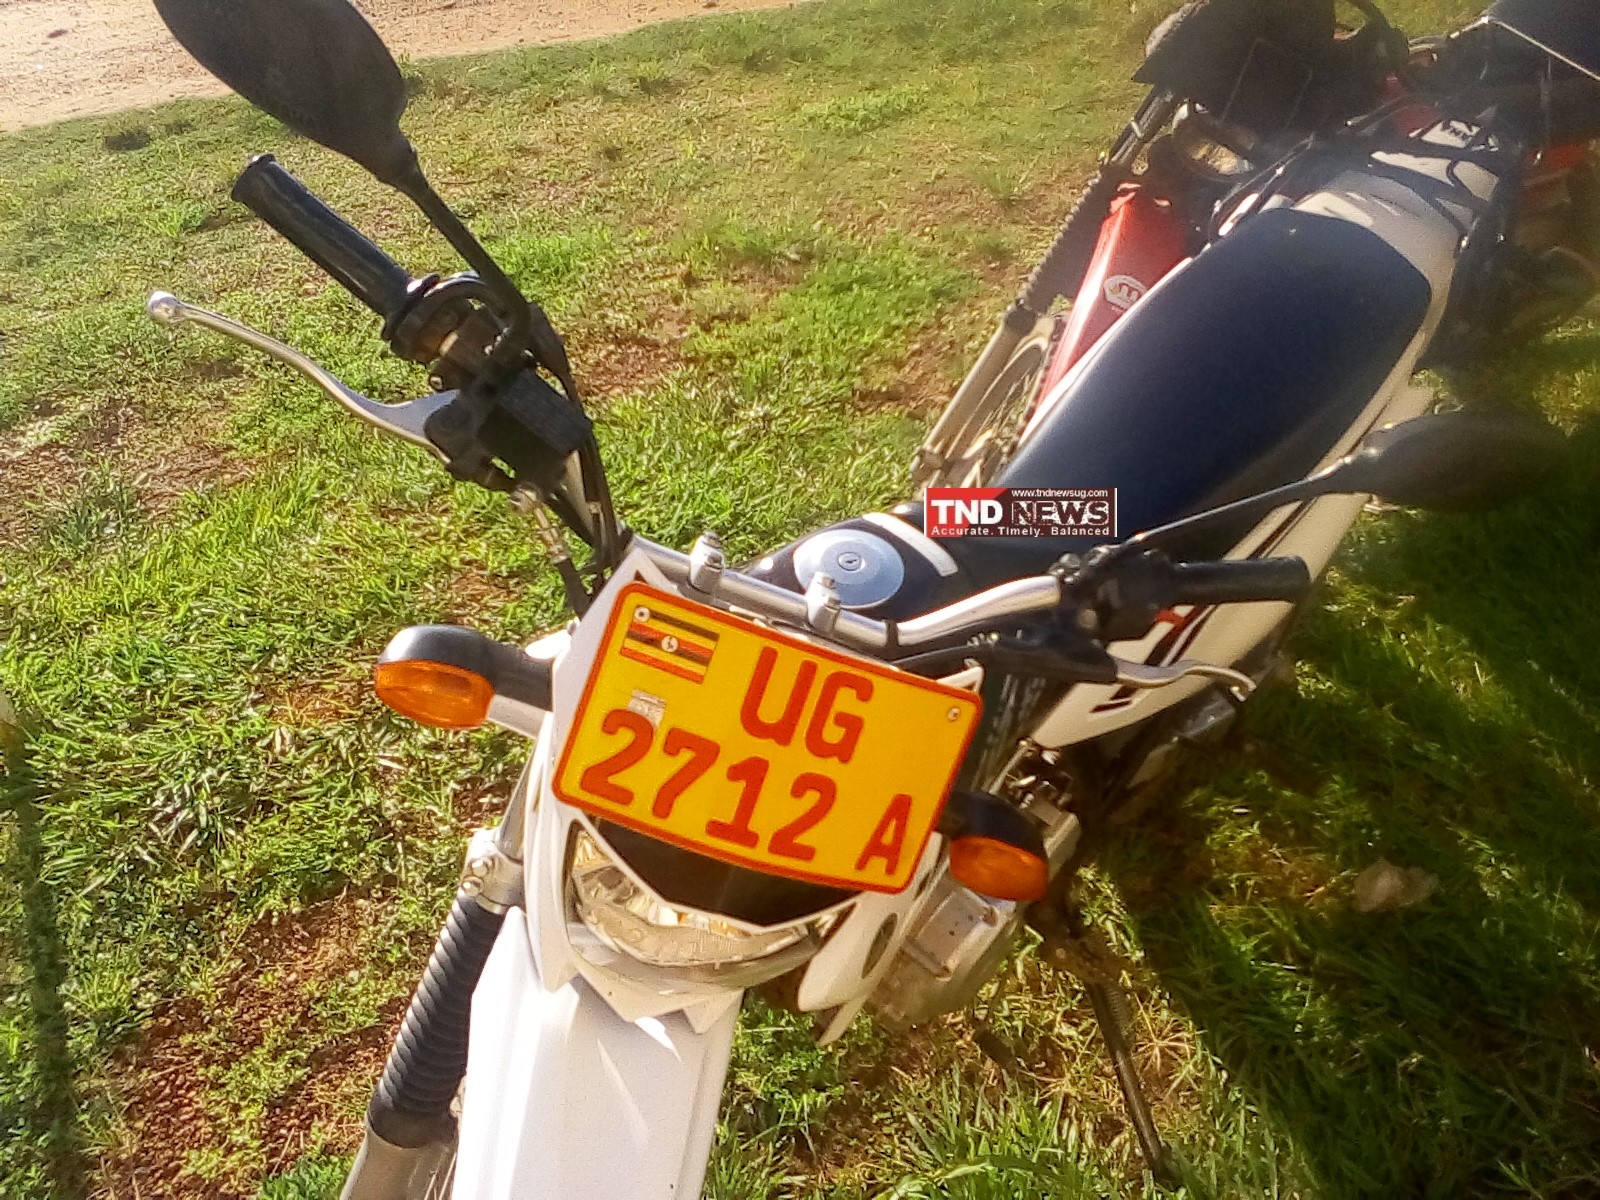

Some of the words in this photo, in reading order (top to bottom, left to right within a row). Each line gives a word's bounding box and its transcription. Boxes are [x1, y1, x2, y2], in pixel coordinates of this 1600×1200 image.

[739, 646, 875, 764] UG
[580, 708, 838, 862] 2712
[854, 793, 913, 875] A
